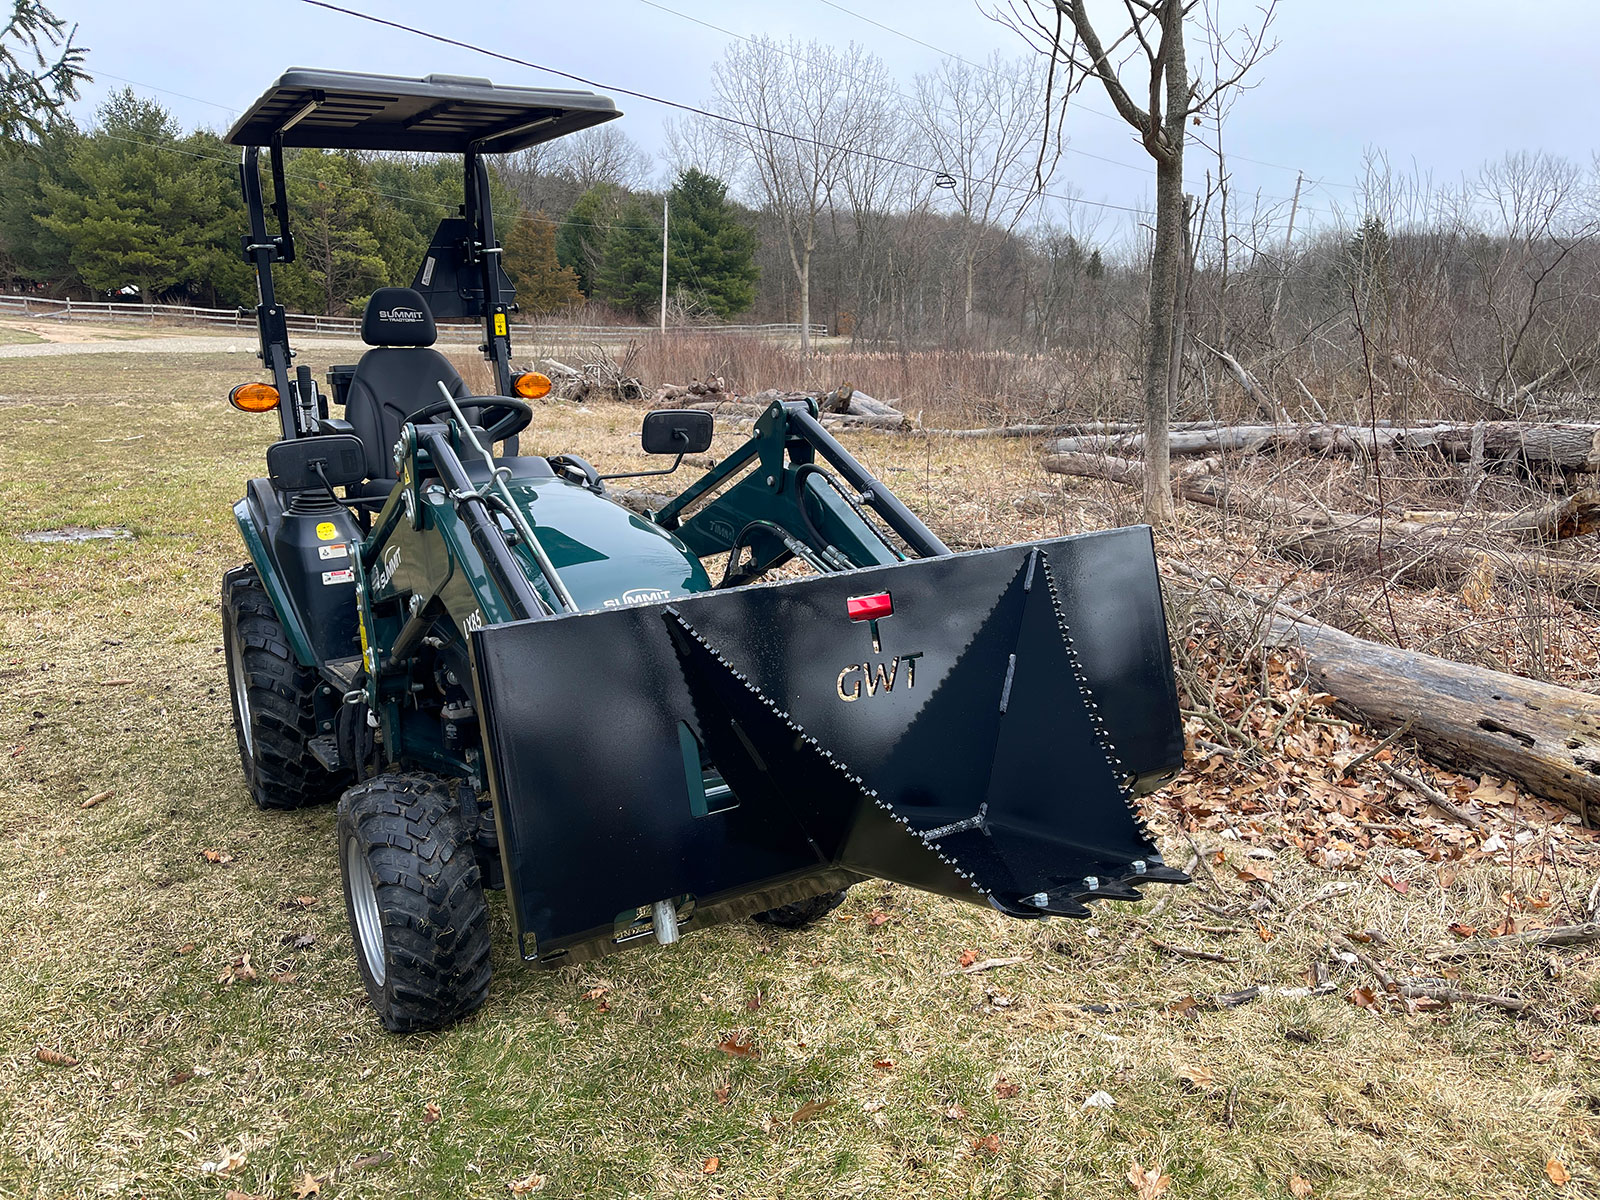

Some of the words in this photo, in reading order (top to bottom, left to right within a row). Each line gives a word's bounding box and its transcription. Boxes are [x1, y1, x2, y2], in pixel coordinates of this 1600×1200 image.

[379, 307, 423, 318] SUMMIT
[380, 545, 402, 589] SUMMIT
[603, 589, 671, 608] SUMMIT
[462, 608, 482, 640] LX85
[836, 652, 924, 702] GWT
